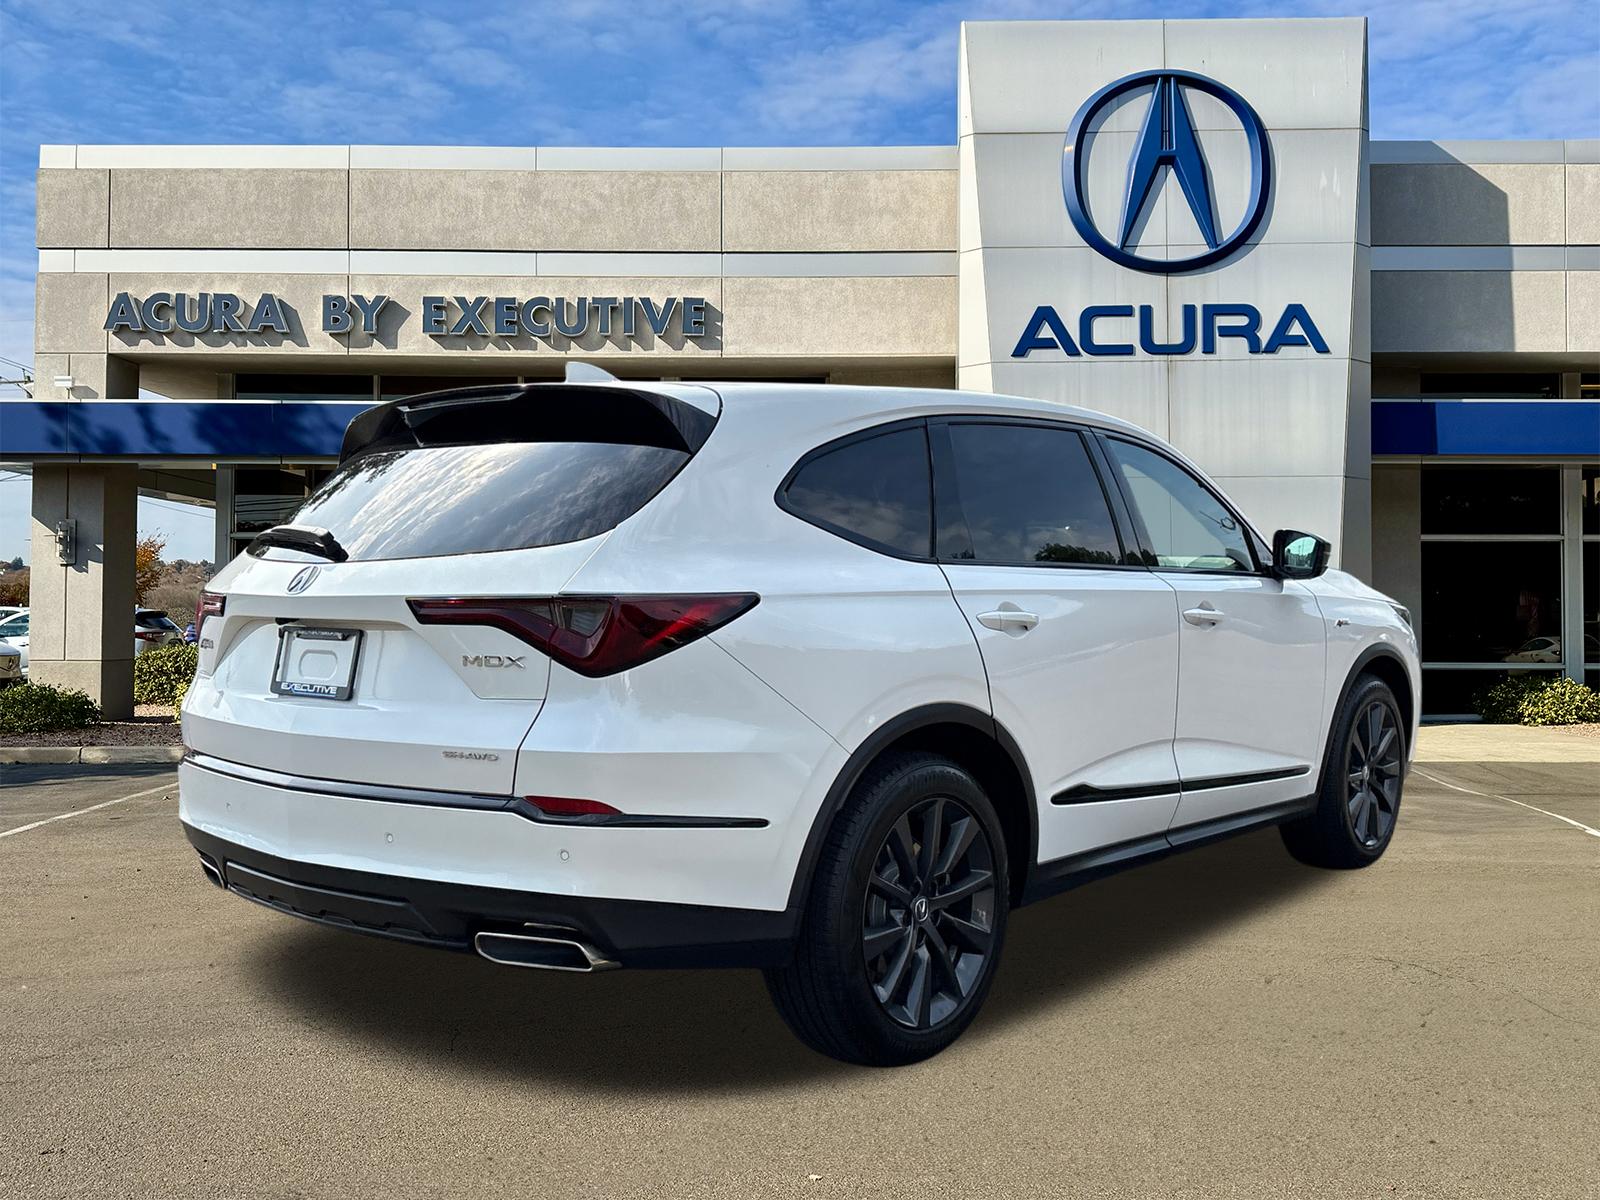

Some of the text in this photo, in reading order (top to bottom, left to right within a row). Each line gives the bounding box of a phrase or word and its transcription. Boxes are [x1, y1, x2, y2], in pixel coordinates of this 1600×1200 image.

[104, 291, 707, 337] ACURA BY EXECUTIVE
[1011, 303, 1332, 358] ACURA
[462, 655, 526, 669] MDX
[281, 682, 338, 695] EXECUTIVE
